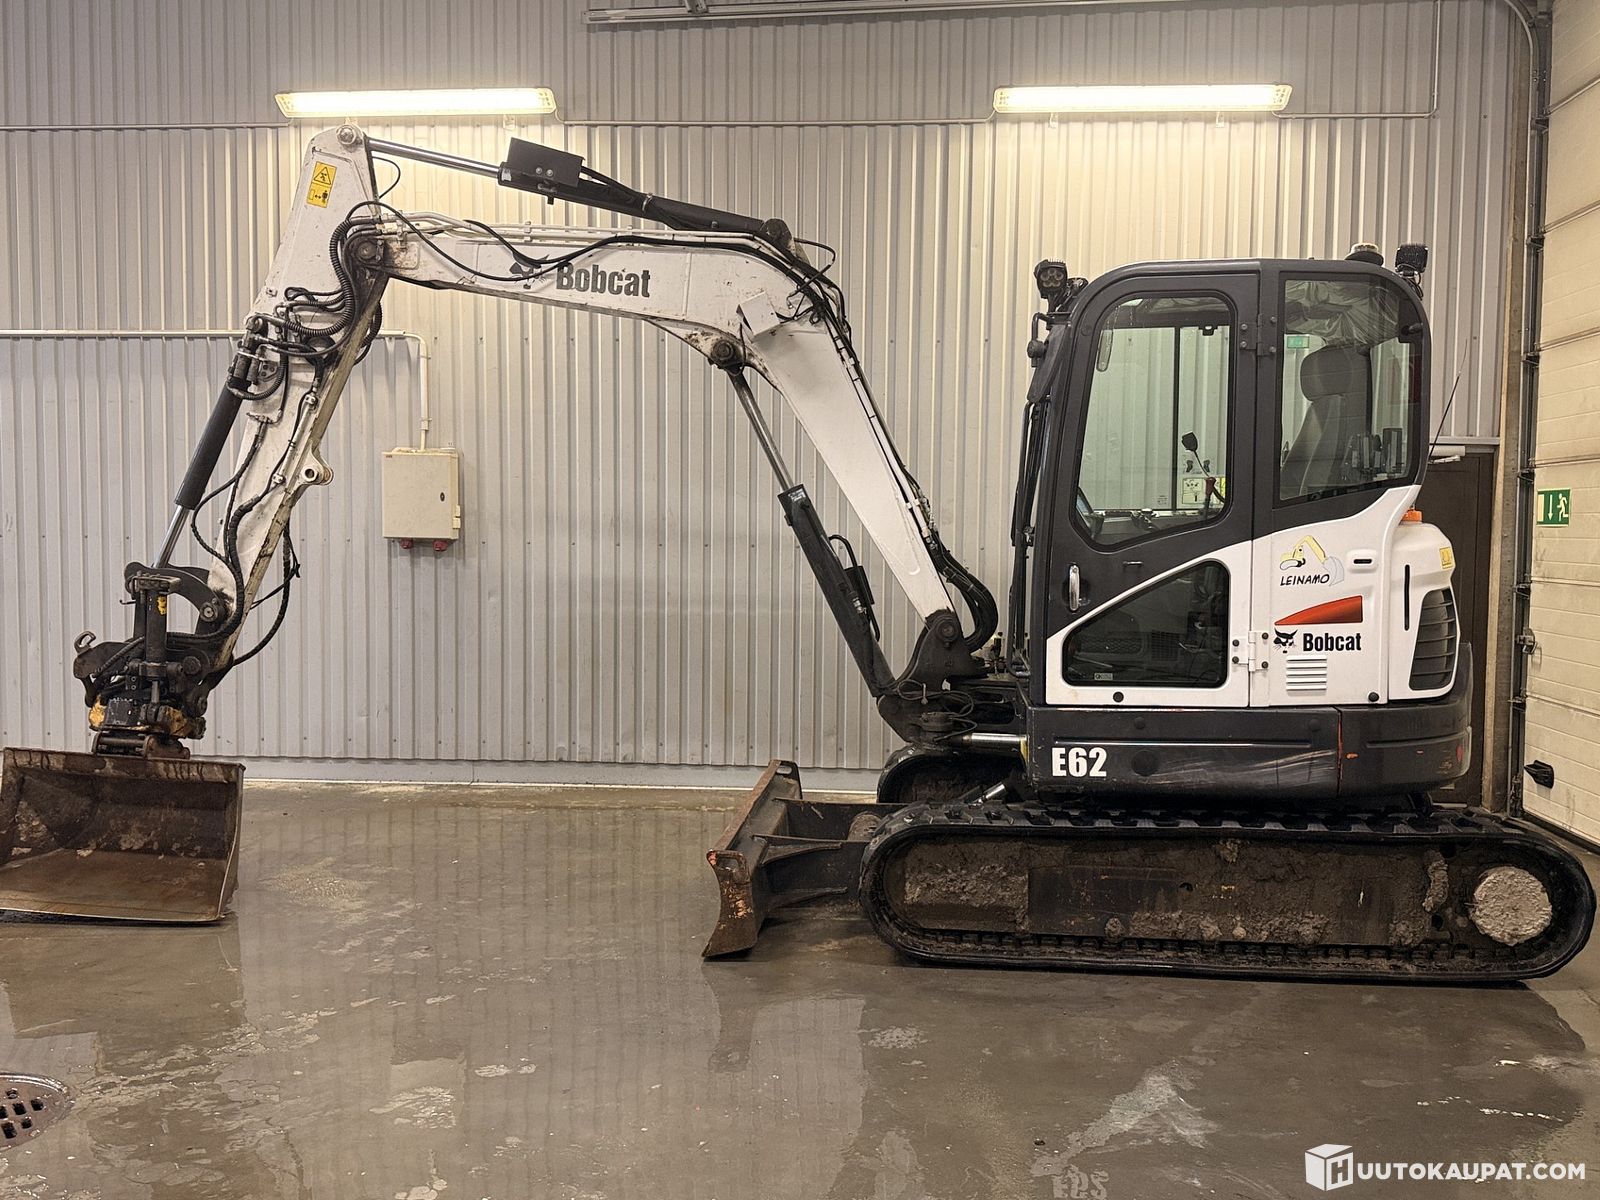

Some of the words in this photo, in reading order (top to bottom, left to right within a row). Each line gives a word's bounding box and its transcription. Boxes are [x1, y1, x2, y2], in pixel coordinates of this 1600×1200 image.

[556, 262, 651, 298] Bobcat
[1280, 573, 1330, 586] LEINAMO
[1303, 632, 1362, 652] Bobcat
[1051, 747, 1107, 777] E62
